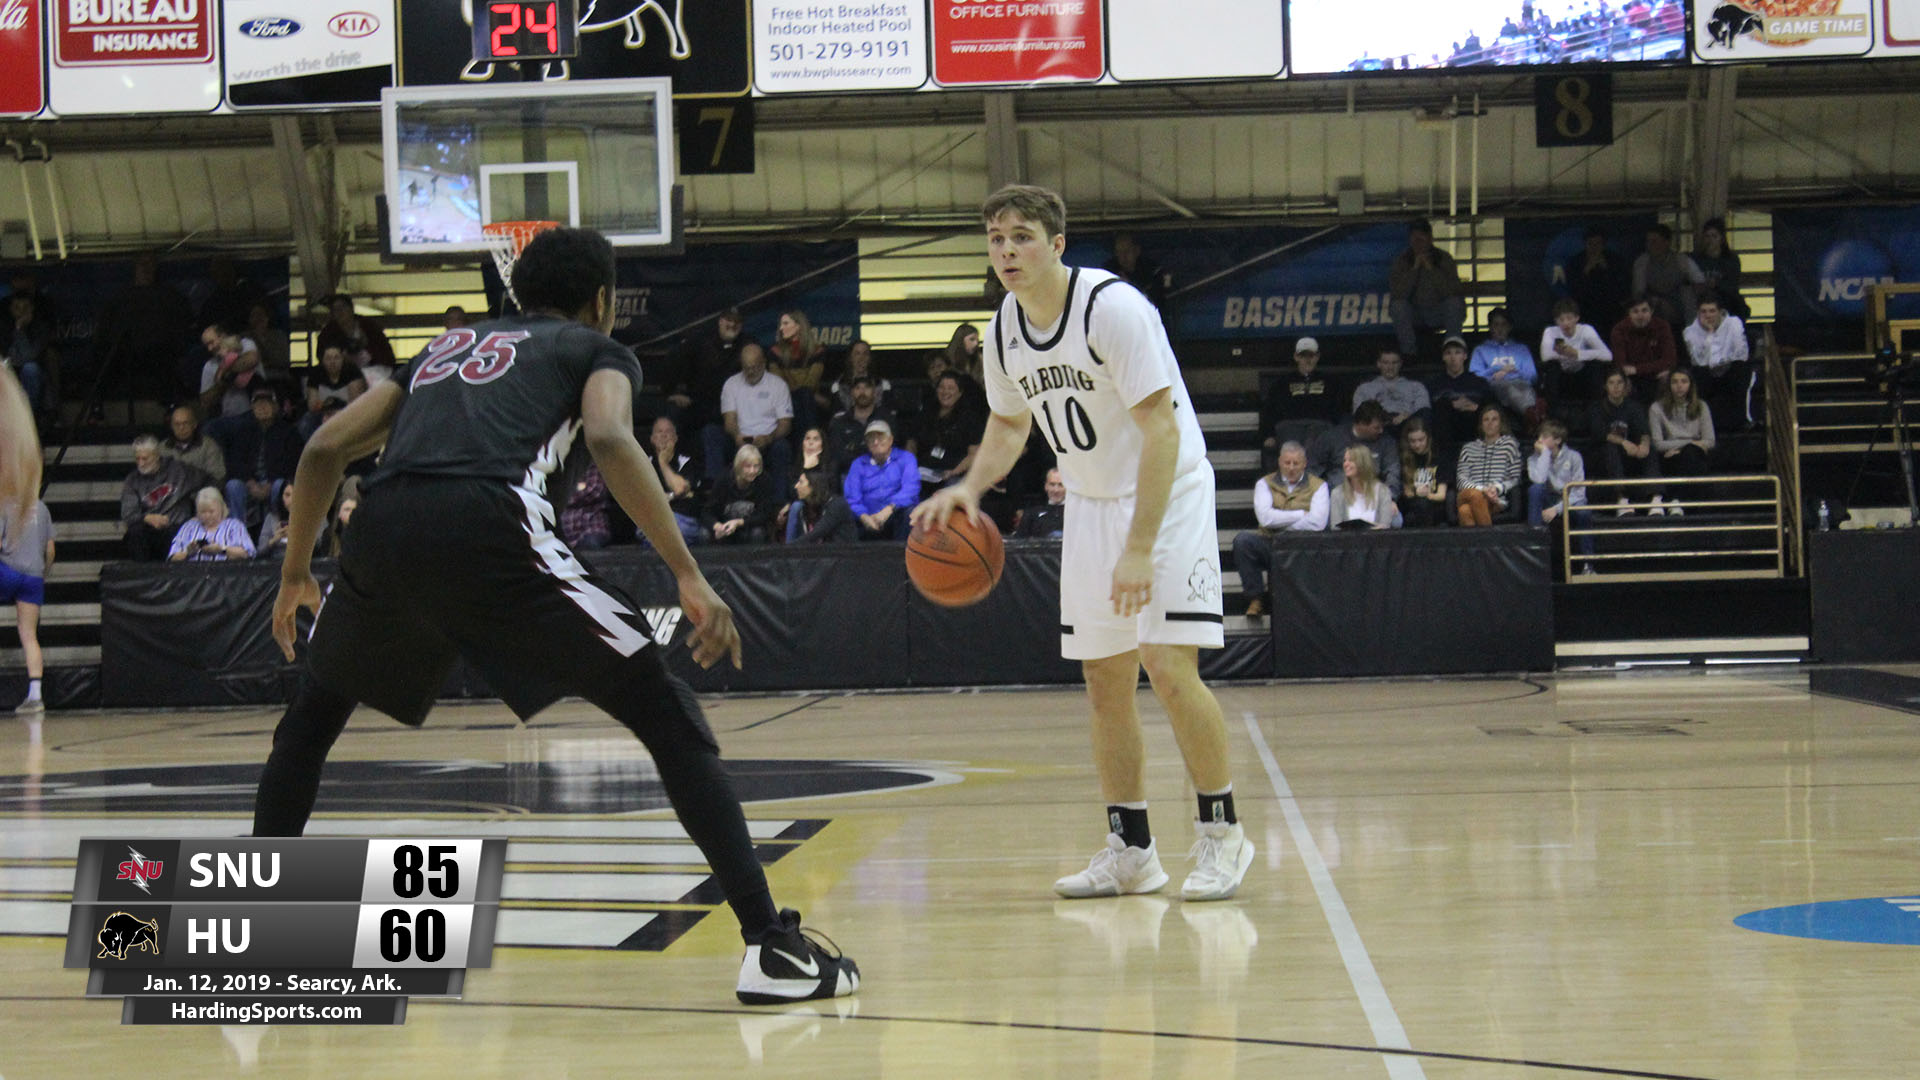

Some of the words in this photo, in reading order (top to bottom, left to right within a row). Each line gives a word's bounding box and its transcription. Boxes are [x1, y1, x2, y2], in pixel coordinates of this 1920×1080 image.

[69, 0, 198, 24] BUREAU
[772, 7, 803, 19] Free
[808, 6, 833, 18] Hot
[838, 4, 907, 17] Breakfast
[951, 5, 1004, 19] OFFICE
[1007, 2, 1085, 17] FURNITURE
[250, 19, 291, 37] Ford
[338, 18, 371, 32] KIA
[490, 2, 558, 57] 24
[768, 22, 817, 36] Indoor
[822, 20, 874, 33] Heated
[879, 18, 911, 32] Pool
[1769, 19, 1818, 35] GAME
[1823, 18, 1864, 33] TIME
[93, 32, 199, 52] INSURANCE
[769, 40, 909, 61] 501-279-9191
[294, 58, 321, 73] the
[325, 50, 362, 68] drive
[1555, 78, 1594, 138] 8
[697, 107, 735, 167] 7
[1223, 295, 1393, 329] BASKETBAL
[410, 328, 531, 394] 25
[1018, 364, 1096, 400] HARDING
[1042, 396, 1097, 454] 10
